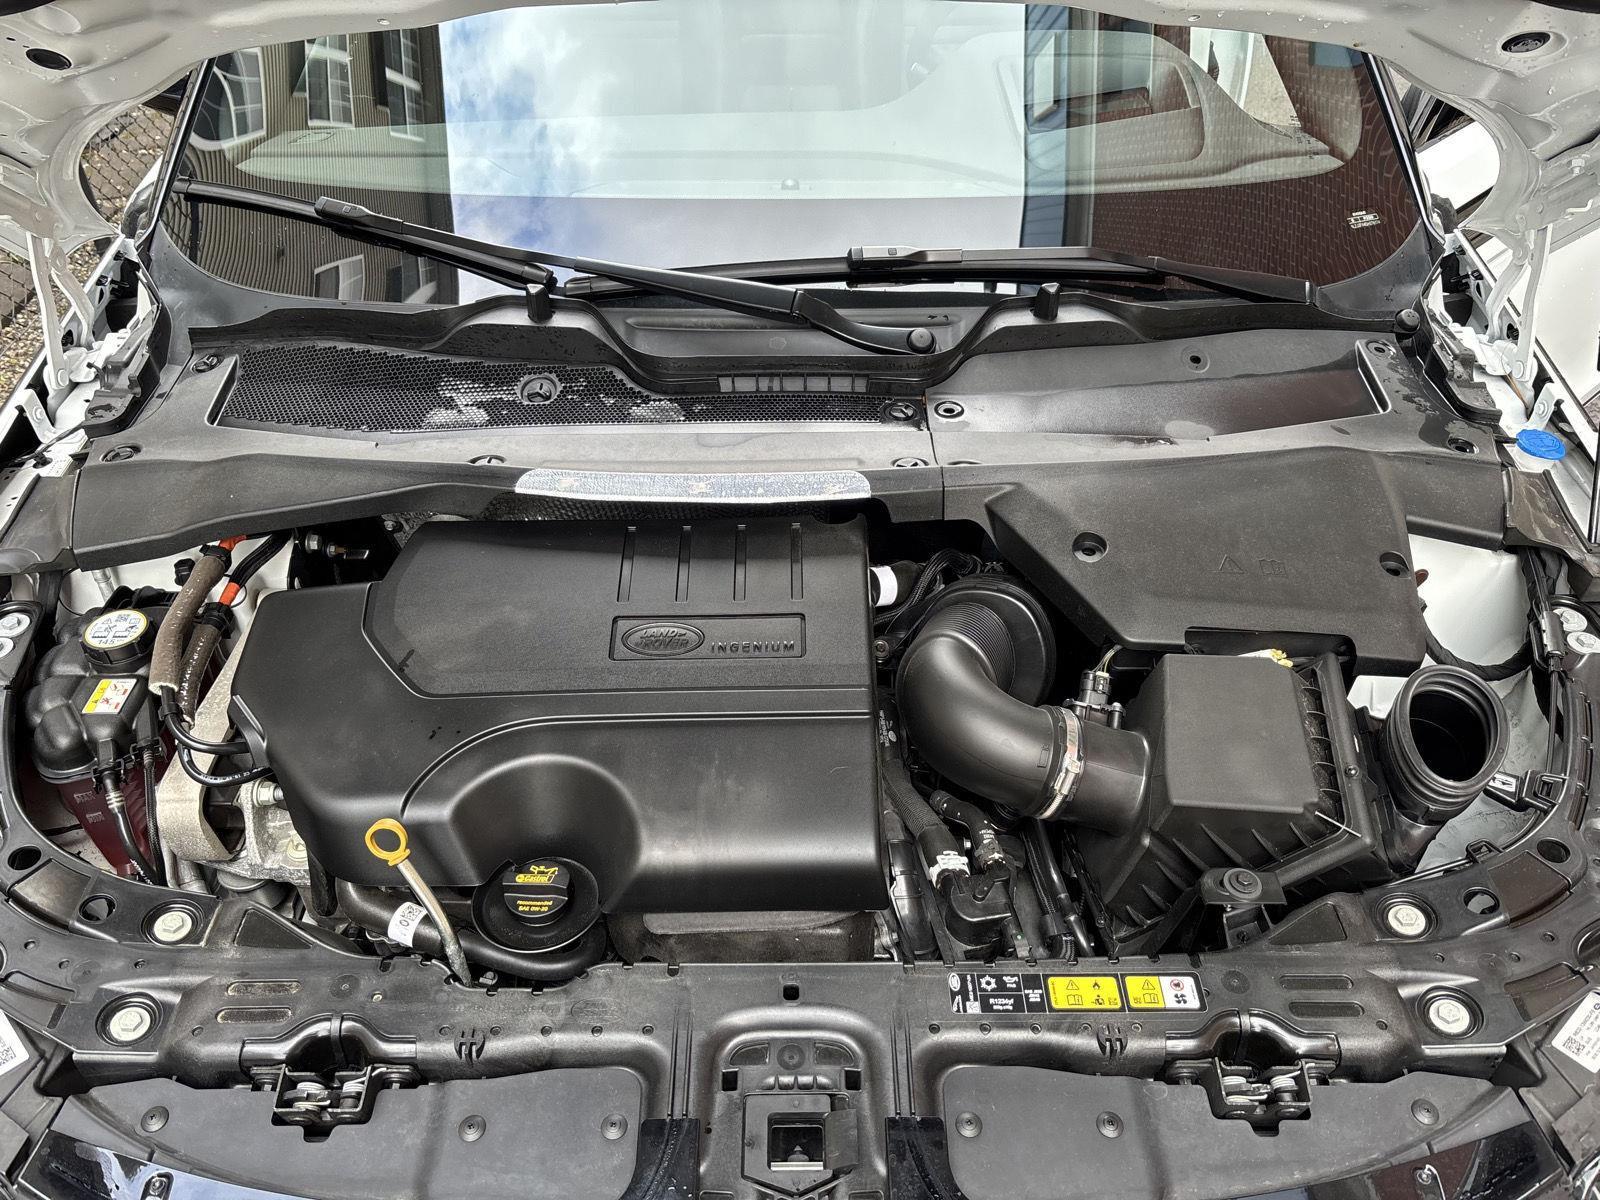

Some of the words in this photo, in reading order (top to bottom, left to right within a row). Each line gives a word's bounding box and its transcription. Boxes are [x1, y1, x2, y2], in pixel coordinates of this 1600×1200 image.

[641, 628, 686, 639] LAND
[640, 638, 690, 649] ROVER
[710, 640, 796, 654] INGENIUM
[524, 874, 550, 883] Castrol
